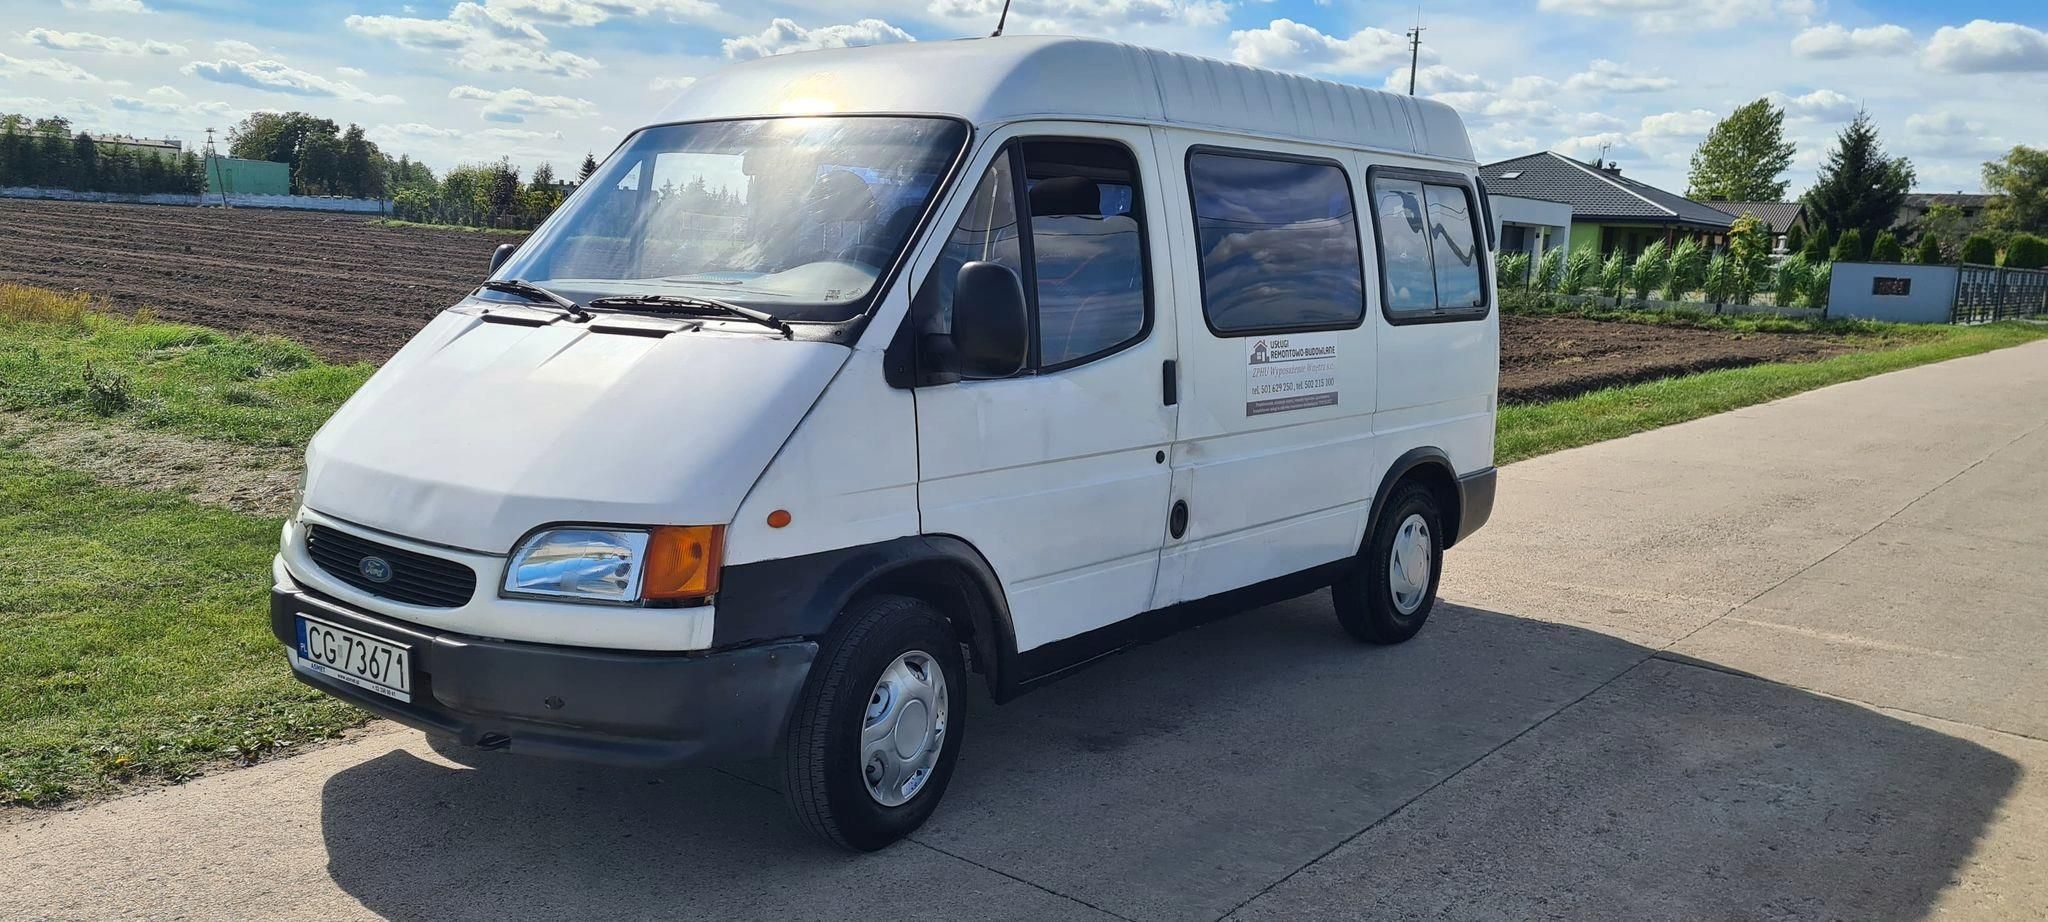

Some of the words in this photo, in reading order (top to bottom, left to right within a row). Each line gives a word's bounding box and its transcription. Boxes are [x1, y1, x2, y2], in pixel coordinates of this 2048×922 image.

[1270, 339, 1289, 349] USŁUGI
[1270, 346, 1336, 359] REMONTOWO-BUDOWLANE
[1261, 384, 1271, 394] 501
[1272, 383, 1283, 393] 629
[1304, 379, 1314, 389] 502
[1314, 378, 1324, 388] 215
[1325, 377, 1335, 386] 100
[364, 560, 385, 577] Ford
[300, 642, 308, 653] PL
[309, 626, 337, 664] CG
[342, 635, 405, 689] 73671
